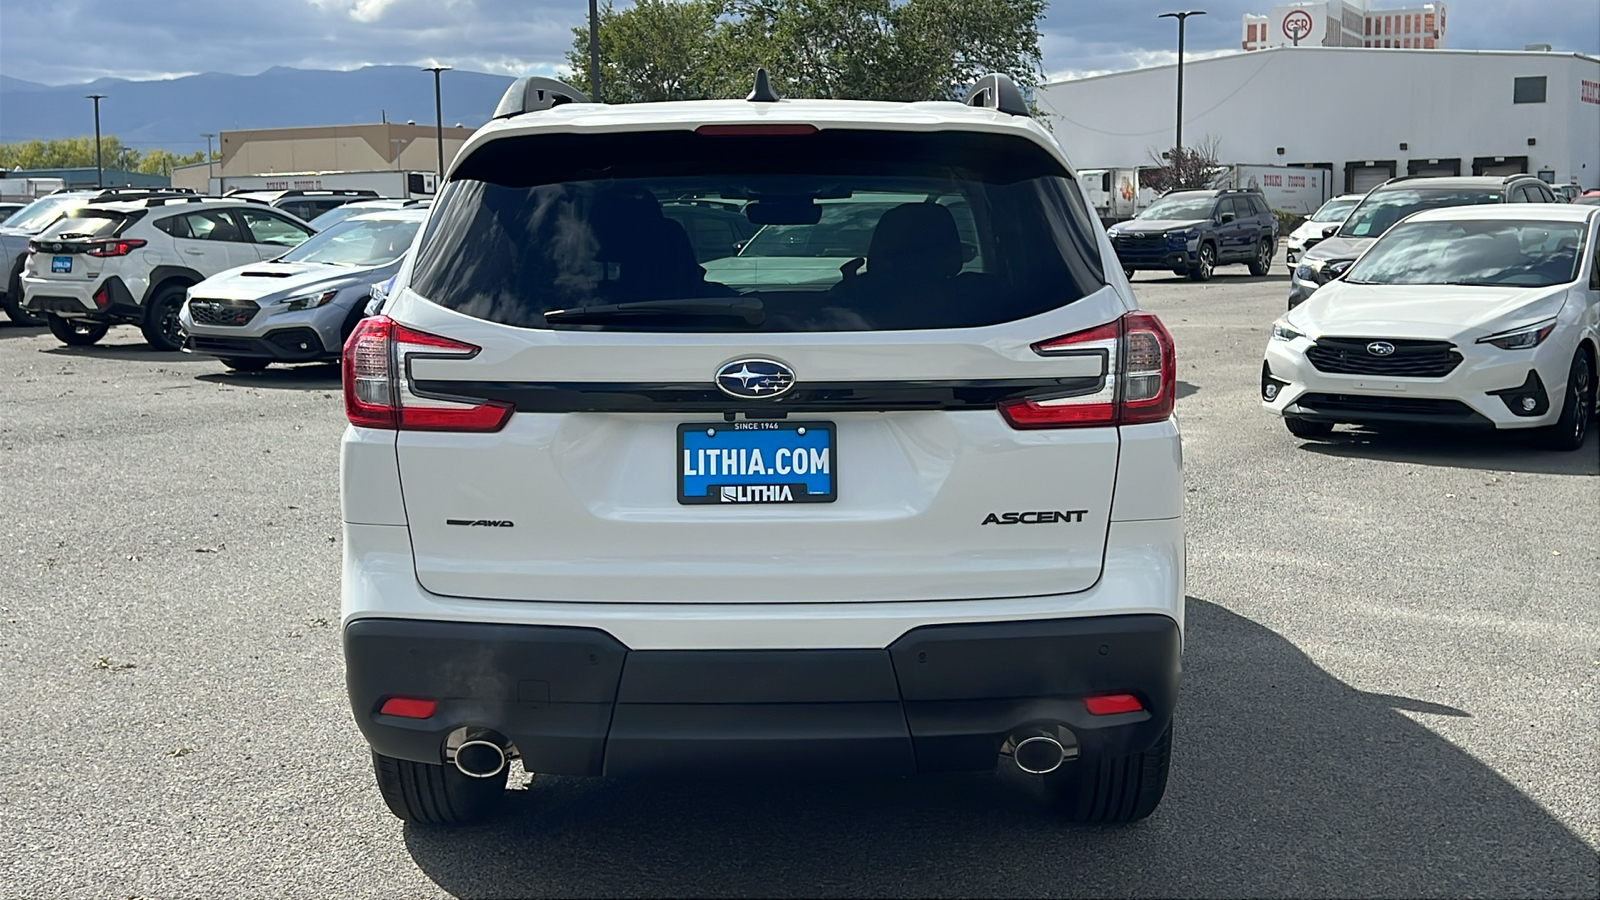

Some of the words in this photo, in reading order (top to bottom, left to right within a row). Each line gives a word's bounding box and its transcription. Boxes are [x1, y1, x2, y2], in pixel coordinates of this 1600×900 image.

[734, 422, 759, 430] SINCE
[760, 422, 779, 430] 1946
[684, 447, 830, 476] LITHIA.COM
[737, 485, 794, 502] LITHIA
[471, 519, 515, 528] AWD
[981, 509, 1089, 526] ASCENT
